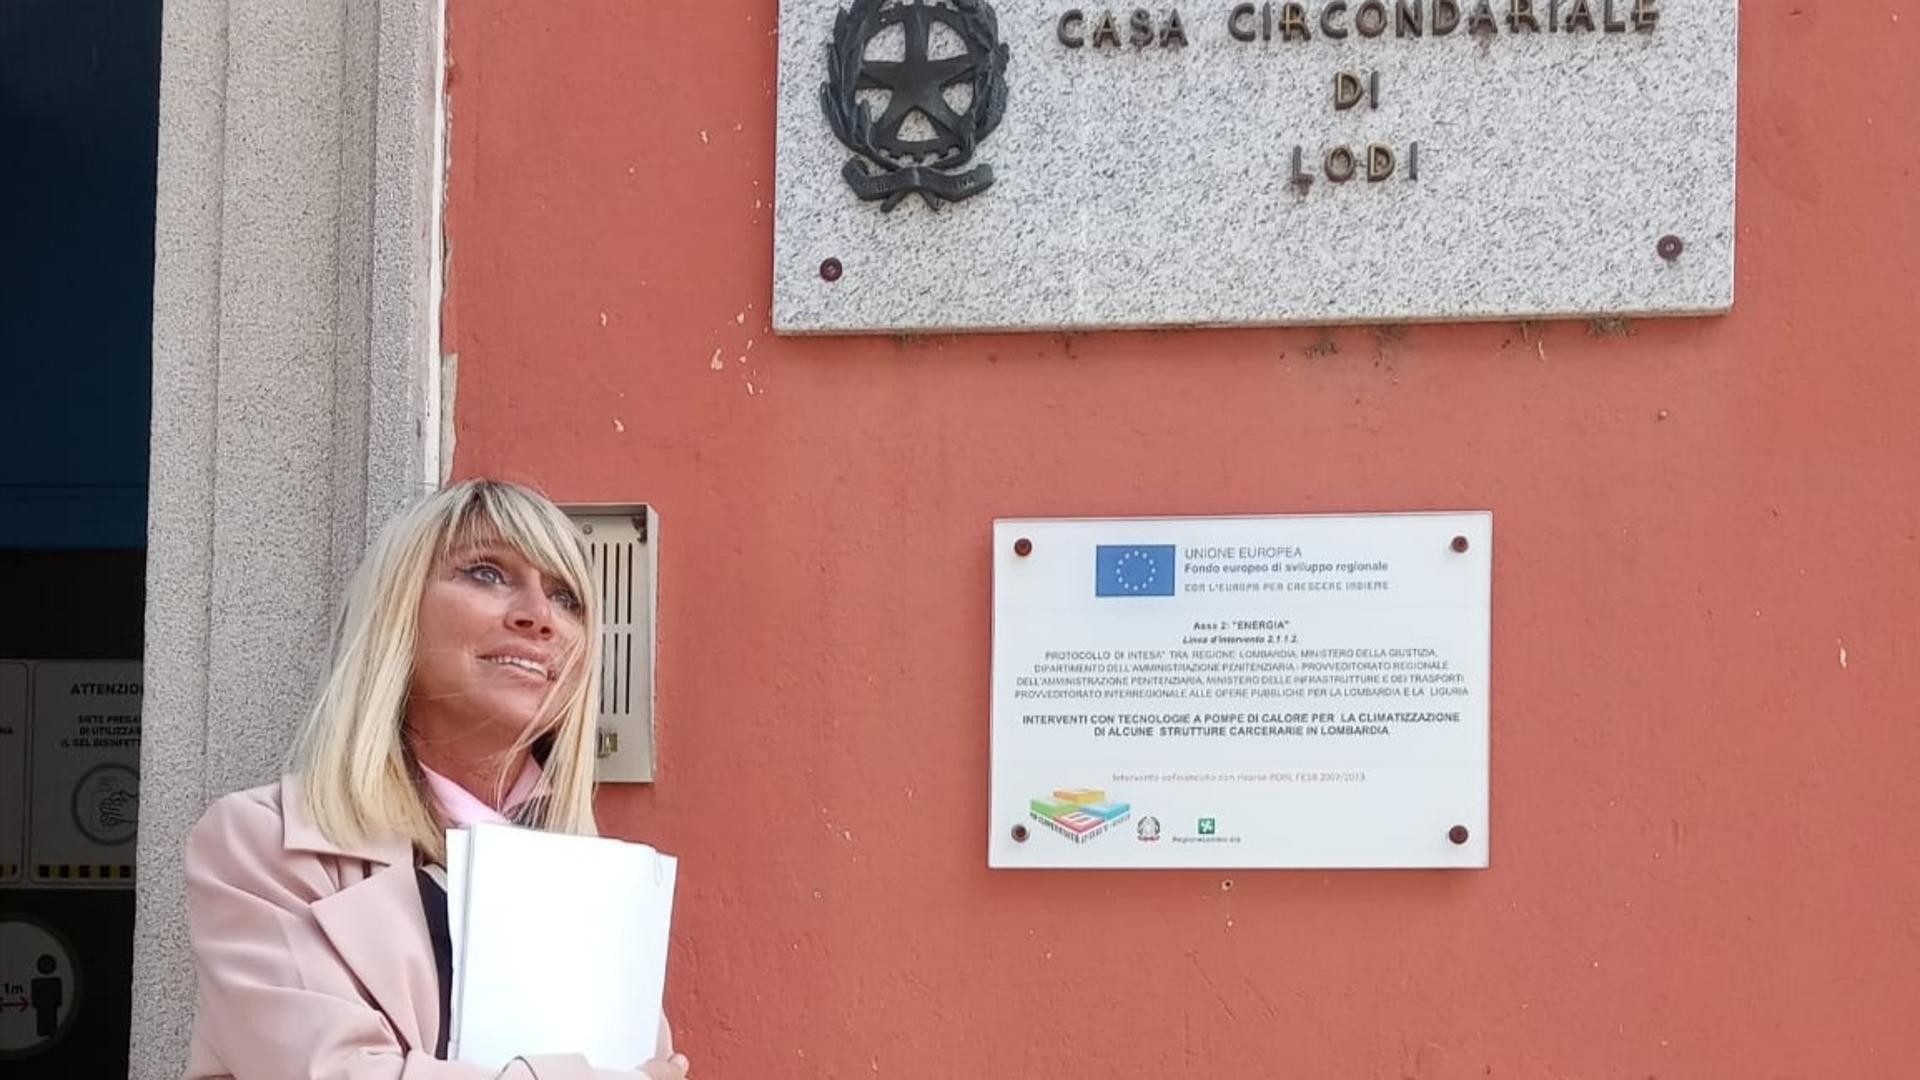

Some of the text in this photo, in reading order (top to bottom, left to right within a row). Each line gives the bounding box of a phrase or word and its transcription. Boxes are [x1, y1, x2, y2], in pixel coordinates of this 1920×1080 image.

[1057, 0, 1660, 49] CASA CIRCONDARIALE
[1334, 70, 1380, 111] DI
[1291, 141, 1418, 184] LODI
[1185, 545, 1302, 559] UNIONE EUROPEA
[1184, 560, 1388, 575] Fondo europeo di sviluppo regionale
[1232, 620, 1290, 631] "ENERGIA"
[1045, 650, 1111, 660] PROTOCOLLO
[1114, 650, 1125, 660] DI
[1169, 649, 1189, 659] TRA
[1192, 649, 1235, 659] REGIONE
[1300, 648, 1354, 658] MINISTERO
[1355, 648, 1387, 658] DELLA
[1034, 663, 1105, 673] DIPARTIMENTO
[1106, 662, 1220, 673] DELL'AMMINISTRAZIONE
[1221, 662, 1295, 672] PENITENZIARIA
[1302, 661, 1392, 672] PROVVEDITORATO
[1393, 660, 1450, 671] REGIONALE
[1016, 676, 1129, 687] DELL'AMMINISTRAZIONE
[1206, 675, 1260, 685] MINISTERO
[1259, 675, 1293, 685] DELLE
[1293, 674, 1380, 685] INFRASTRUTTURE
[1382, 674, 1390, 683] E
[1390, 674, 1407, 683] DEI
[1409, 672, 1465, 683] TRASPORTI
[1014, 689, 1102, 699] PROVVEDITORATO
[1104, 688, 1188, 699] INTERREGIONALE
[1188, 688, 1213, 698] ALLE
[1214, 688, 1249, 698] OPERE
[1250, 687, 1305, 698] PUBBLICHE
[1307, 687, 1327, 697] PER
[1329, 687, 1342, 697] LA
[1343, 687, 1400, 697] LOMBARDIA
[1412, 686, 1425, 696] LA
[1430, 686, 1470, 697] LIGURIA
[1022, 711, 1462, 725] INTERVENTI CON TECNOLOGIE A POMPE DI CALORE PER LA CLIMATIZZAZIONE
[1094, 725, 1389, 737] DI ALCUNE STRUTTURE CARCERARIE IN LOMBARDIA
[4, 982, 24, 995] 1m
